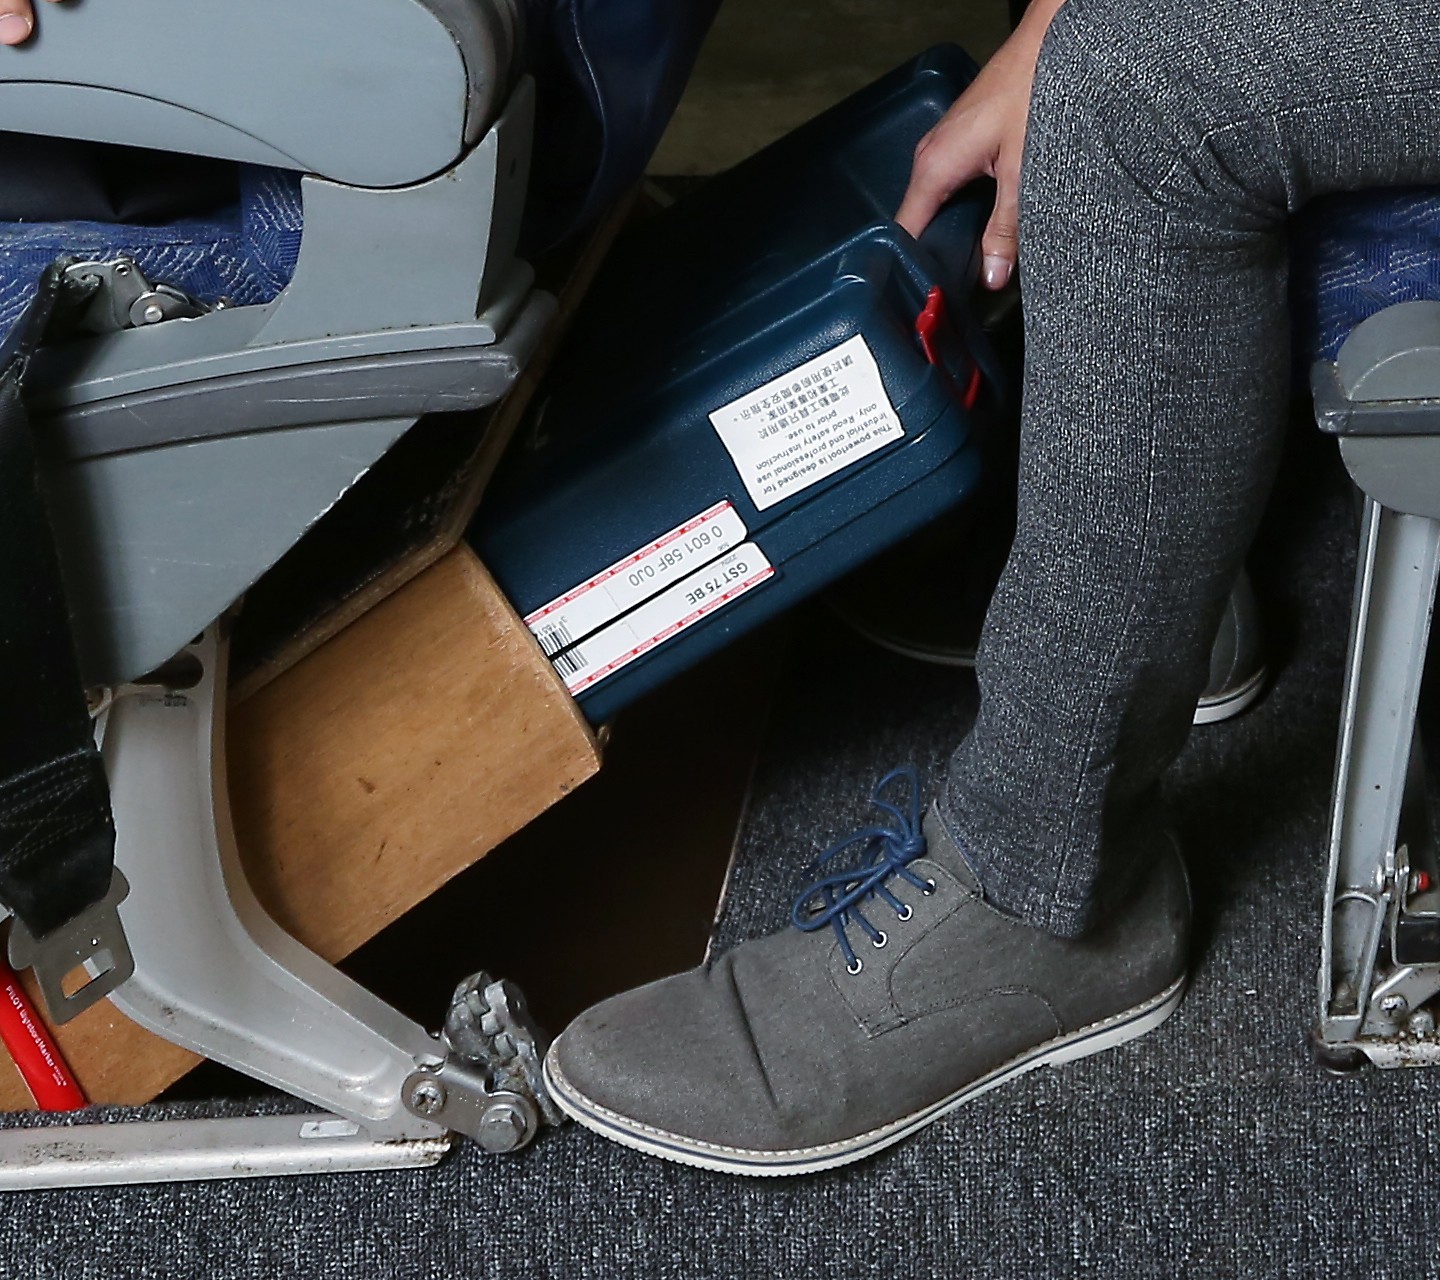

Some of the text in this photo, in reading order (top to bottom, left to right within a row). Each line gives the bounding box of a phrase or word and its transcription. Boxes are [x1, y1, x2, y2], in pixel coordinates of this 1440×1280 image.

[754, 400, 878, 473] only. Read safety instruction
[784, 408, 838, 442] prior to use.
[871, 421, 893, 438] This
[826, 431, 872, 462] powertool
[827, 432, 846, 448] and
[772, 440, 828, 478] professional
[755, 471, 773, 485] use
[775, 459, 818, 489] designed
[761, 482, 777, 496] for
[682, 530, 712, 555] 601
[709, 523, 724, 539] 0
[653, 547, 684, 572] 58F
[626, 563, 656, 587] 0J0
[684, 560, 749, 606] GST 75 BE
[5, 984, 24, 1010] PILOT
[38, 1040, 55, 1067] Marker
